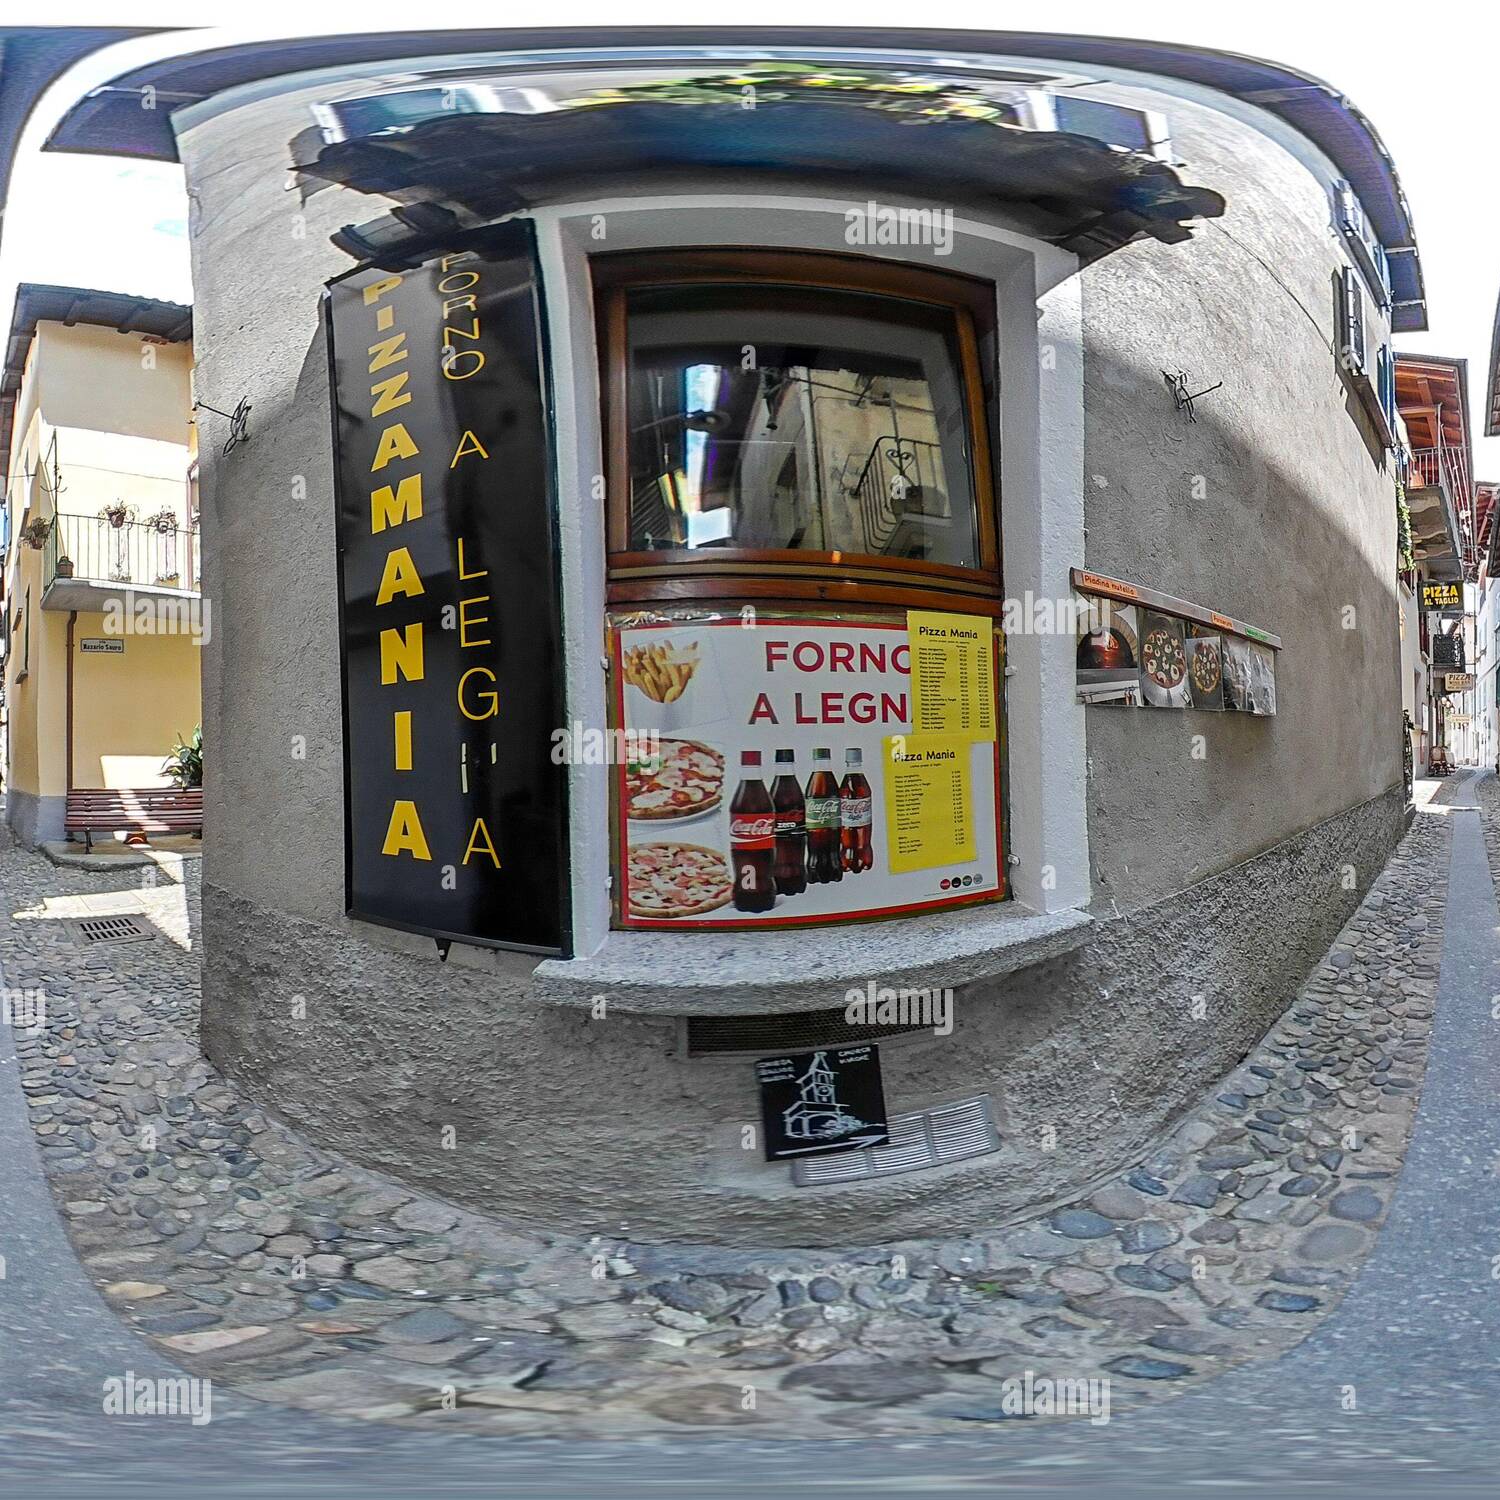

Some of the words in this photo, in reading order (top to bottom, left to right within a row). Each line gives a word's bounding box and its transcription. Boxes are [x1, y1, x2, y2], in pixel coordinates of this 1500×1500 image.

[438, 250, 486, 381] FORNO
[450, 430, 489, 469] A
[362, 275, 433, 861] PIZZAMANIA
[1423, 585, 1459, 598] PIZZA
[1424, 598, 1434, 606] AL
[1434, 597, 1459, 605] TAGLIO
[919, 626, 946, 637] Pizza
[950, 628, 978, 639] Mania
[748, 693, 779, 724] A
[795, 692, 913, 724] LEGN
[894, 752, 922, 762] Pizza
[926, 749, 955, 760] Mania
